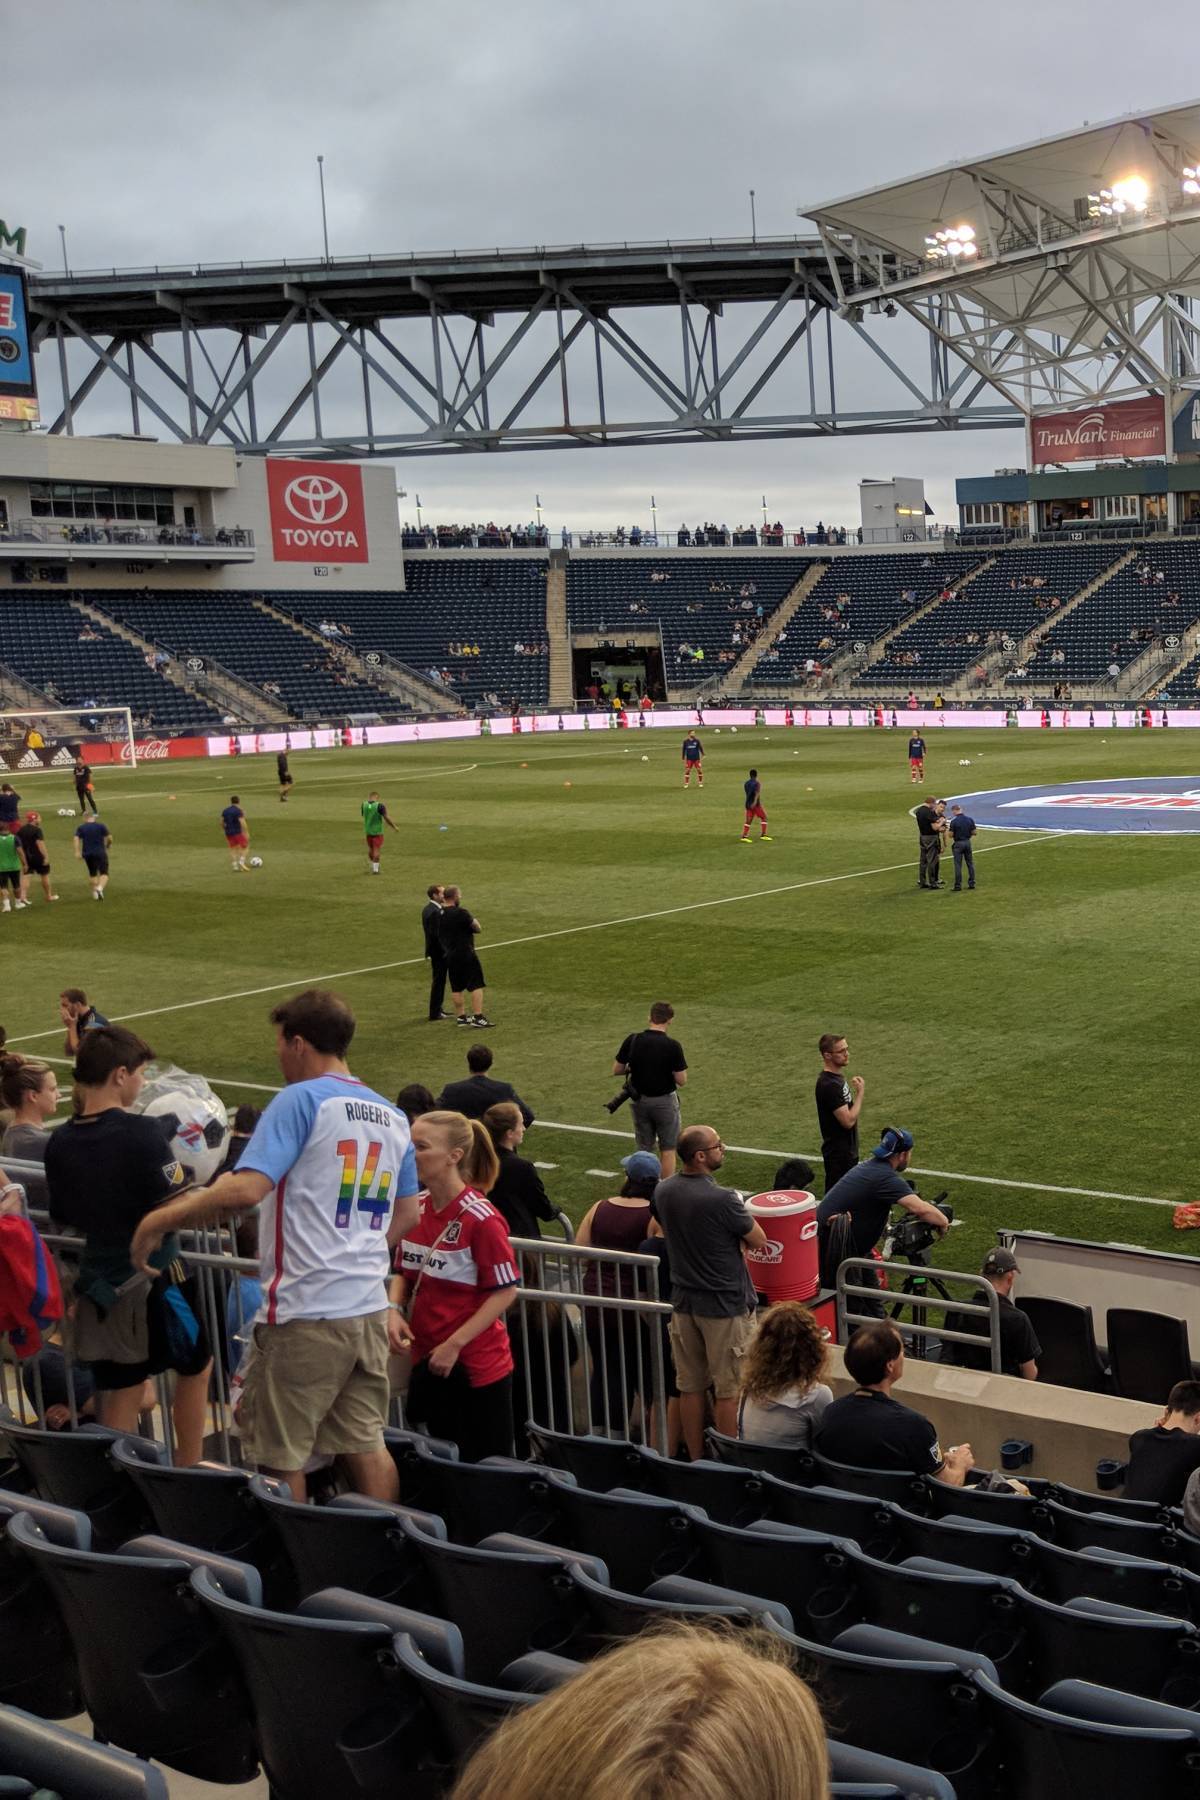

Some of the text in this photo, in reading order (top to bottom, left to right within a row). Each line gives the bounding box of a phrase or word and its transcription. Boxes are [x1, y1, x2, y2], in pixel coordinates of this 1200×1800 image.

[1038, 427, 1108, 447] TruMark
[281, 528, 359, 548] TOYOTA
[345, 1102, 391, 1128] ROGERS
[335, 1139, 392, 1230] 14
[403, 1251, 448, 1270] EST UY
